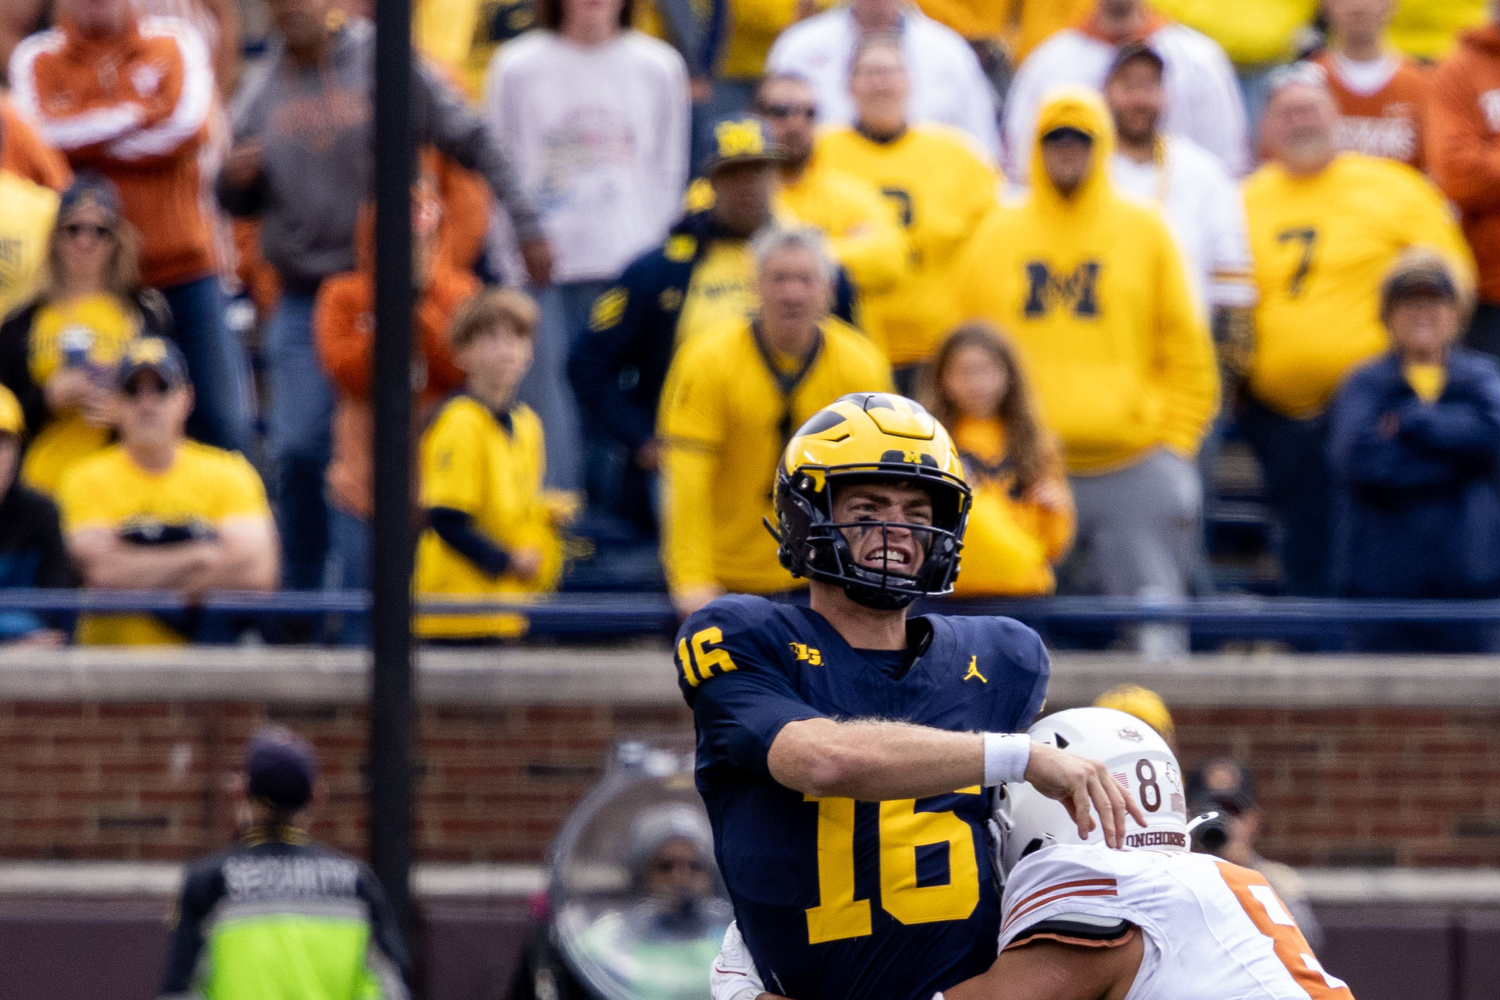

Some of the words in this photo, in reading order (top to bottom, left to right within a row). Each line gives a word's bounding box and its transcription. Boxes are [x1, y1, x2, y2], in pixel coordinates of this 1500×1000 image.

[1024, 262, 1102, 317] M
[1277, 228, 1318, 299] 7
[902, 450, 922, 464] M
[678, 626, 738, 687] 16
[1136, 758, 1162, 813] 8
[803, 785, 981, 945] 16
[1126, 831, 1186, 848] ONGHORNS
